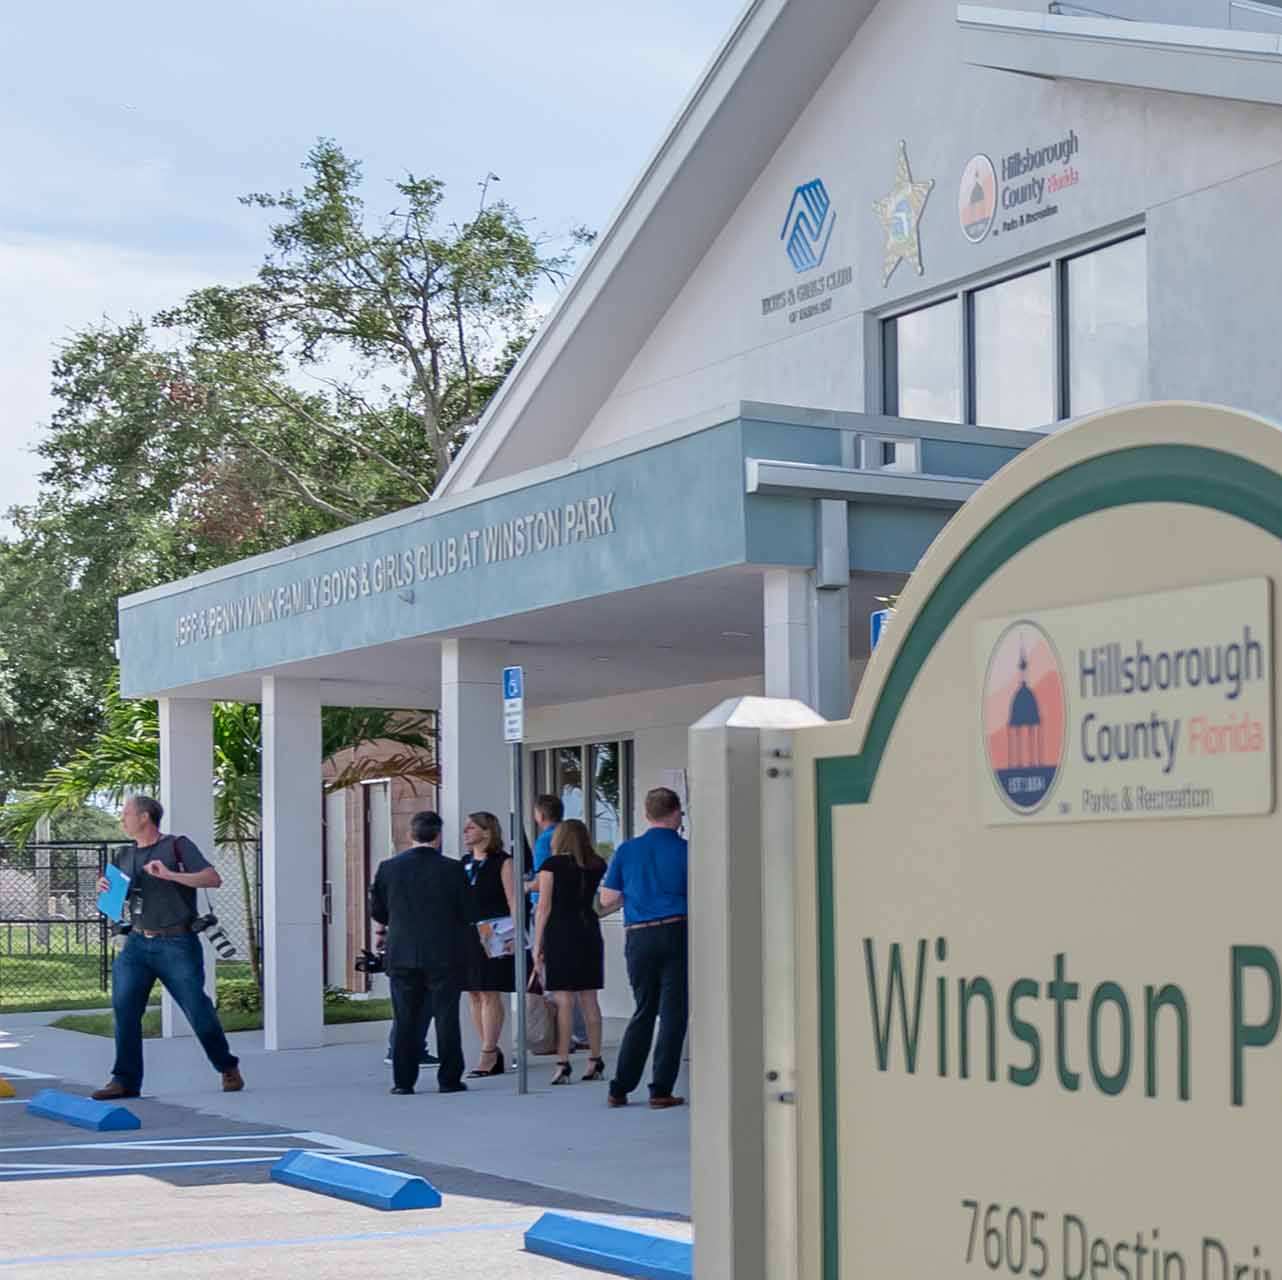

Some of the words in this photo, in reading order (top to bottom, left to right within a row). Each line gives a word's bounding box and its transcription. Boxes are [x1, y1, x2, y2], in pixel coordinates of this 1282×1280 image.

[1001, 129, 1079, 182] Hillsborough
[1001, 177, 1045, 210] County
[208, 599, 245, 638] PENNY
[278, 576, 320, 619] FAMILY
[320, 567, 357, 607] BOYS
[359, 562, 372, 597] &
[373, 550, 415, 593] GIRLS
[416, 536, 459, 581] CLUB
[460, 530, 482, 569] AT
[482, 509, 563, 563] WINSTON
[563, 491, 616, 545] PARK
[1079, 624, 1263, 700] Hillsborough
[1080, 710, 1181, 774] County
[1189, 713, 1266, 755] Florida
[1081, 786, 1119, 813] Parks
[1121, 787, 1133, 811] &
[1135, 783, 1213, 810] Recreation
[863, 936, 1190, 1102] Winston
[961, 1199, 1050, 1279] 7605
